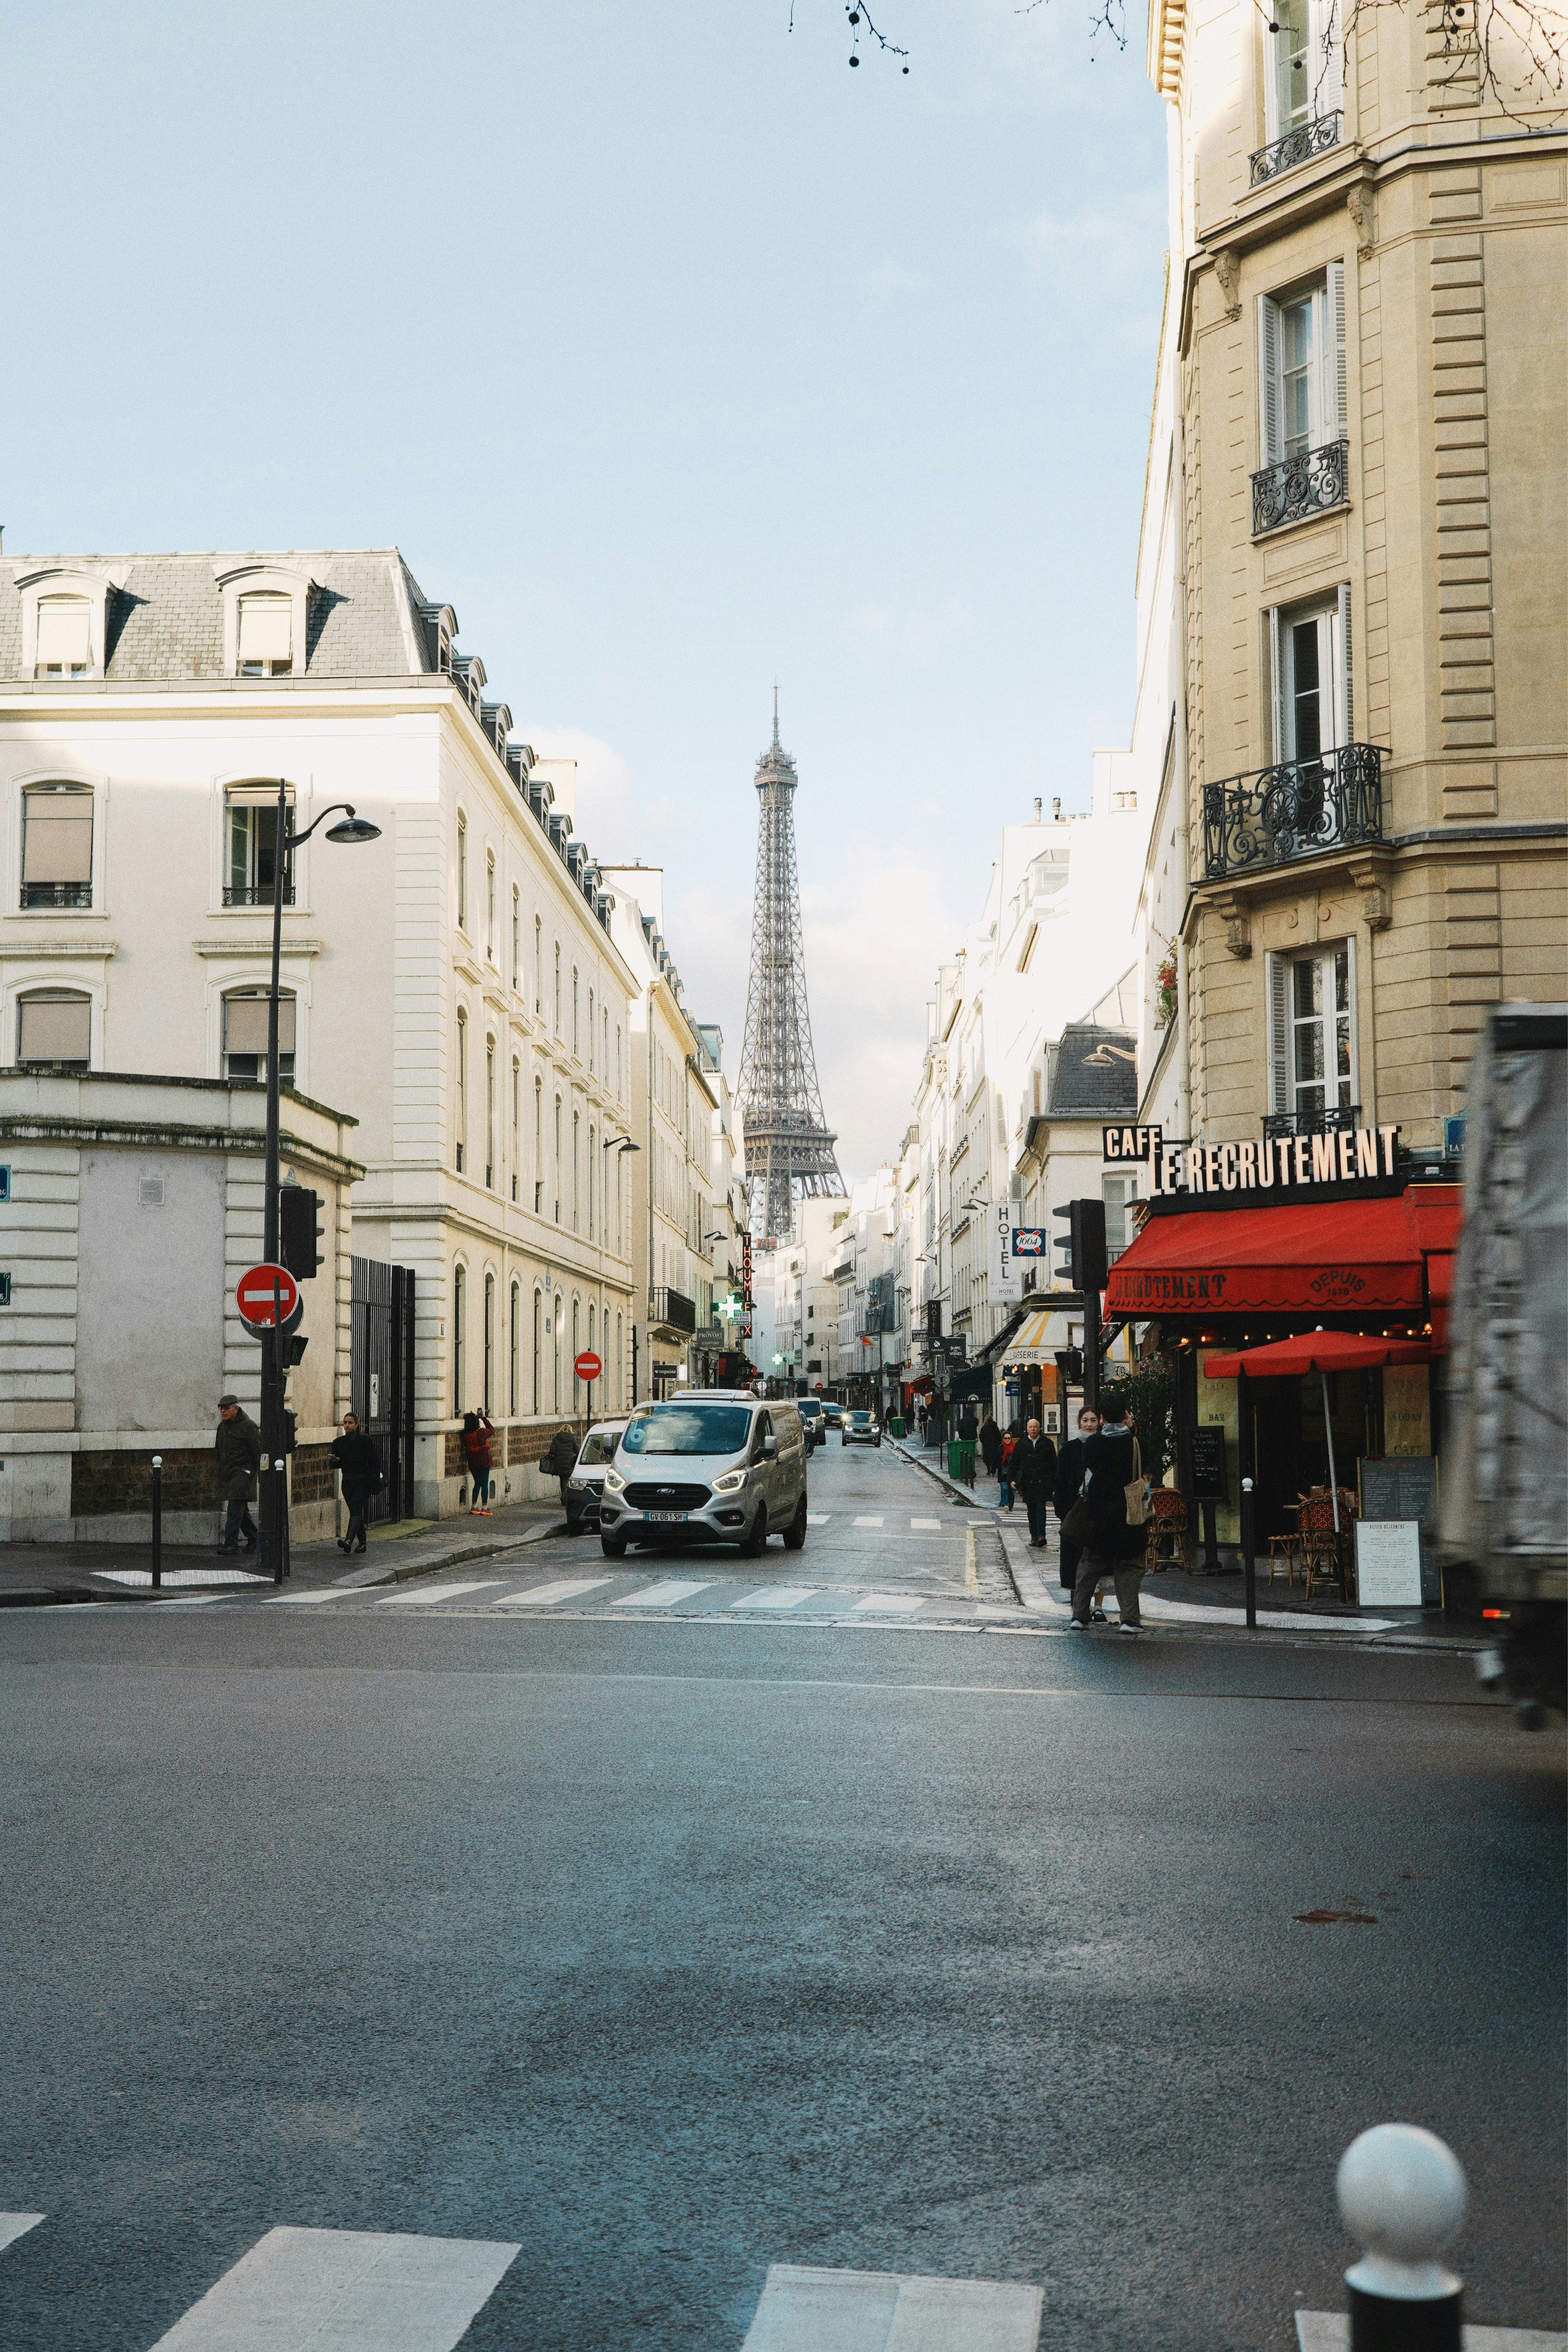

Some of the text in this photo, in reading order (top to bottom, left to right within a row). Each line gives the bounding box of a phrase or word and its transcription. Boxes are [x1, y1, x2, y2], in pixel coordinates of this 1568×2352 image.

[1106, 1127, 1160, 1158] CAFE
[1149, 1125, 1399, 1197] LE RECRUTEMENT
[998, 1207, 1010, 1279] HOTEL
[1019, 1236, 1039, 1245] 1664
[743, 1235, 752, 1336] THOUMIEX
[1310, 1270, 1366, 1293] DEPUIS
